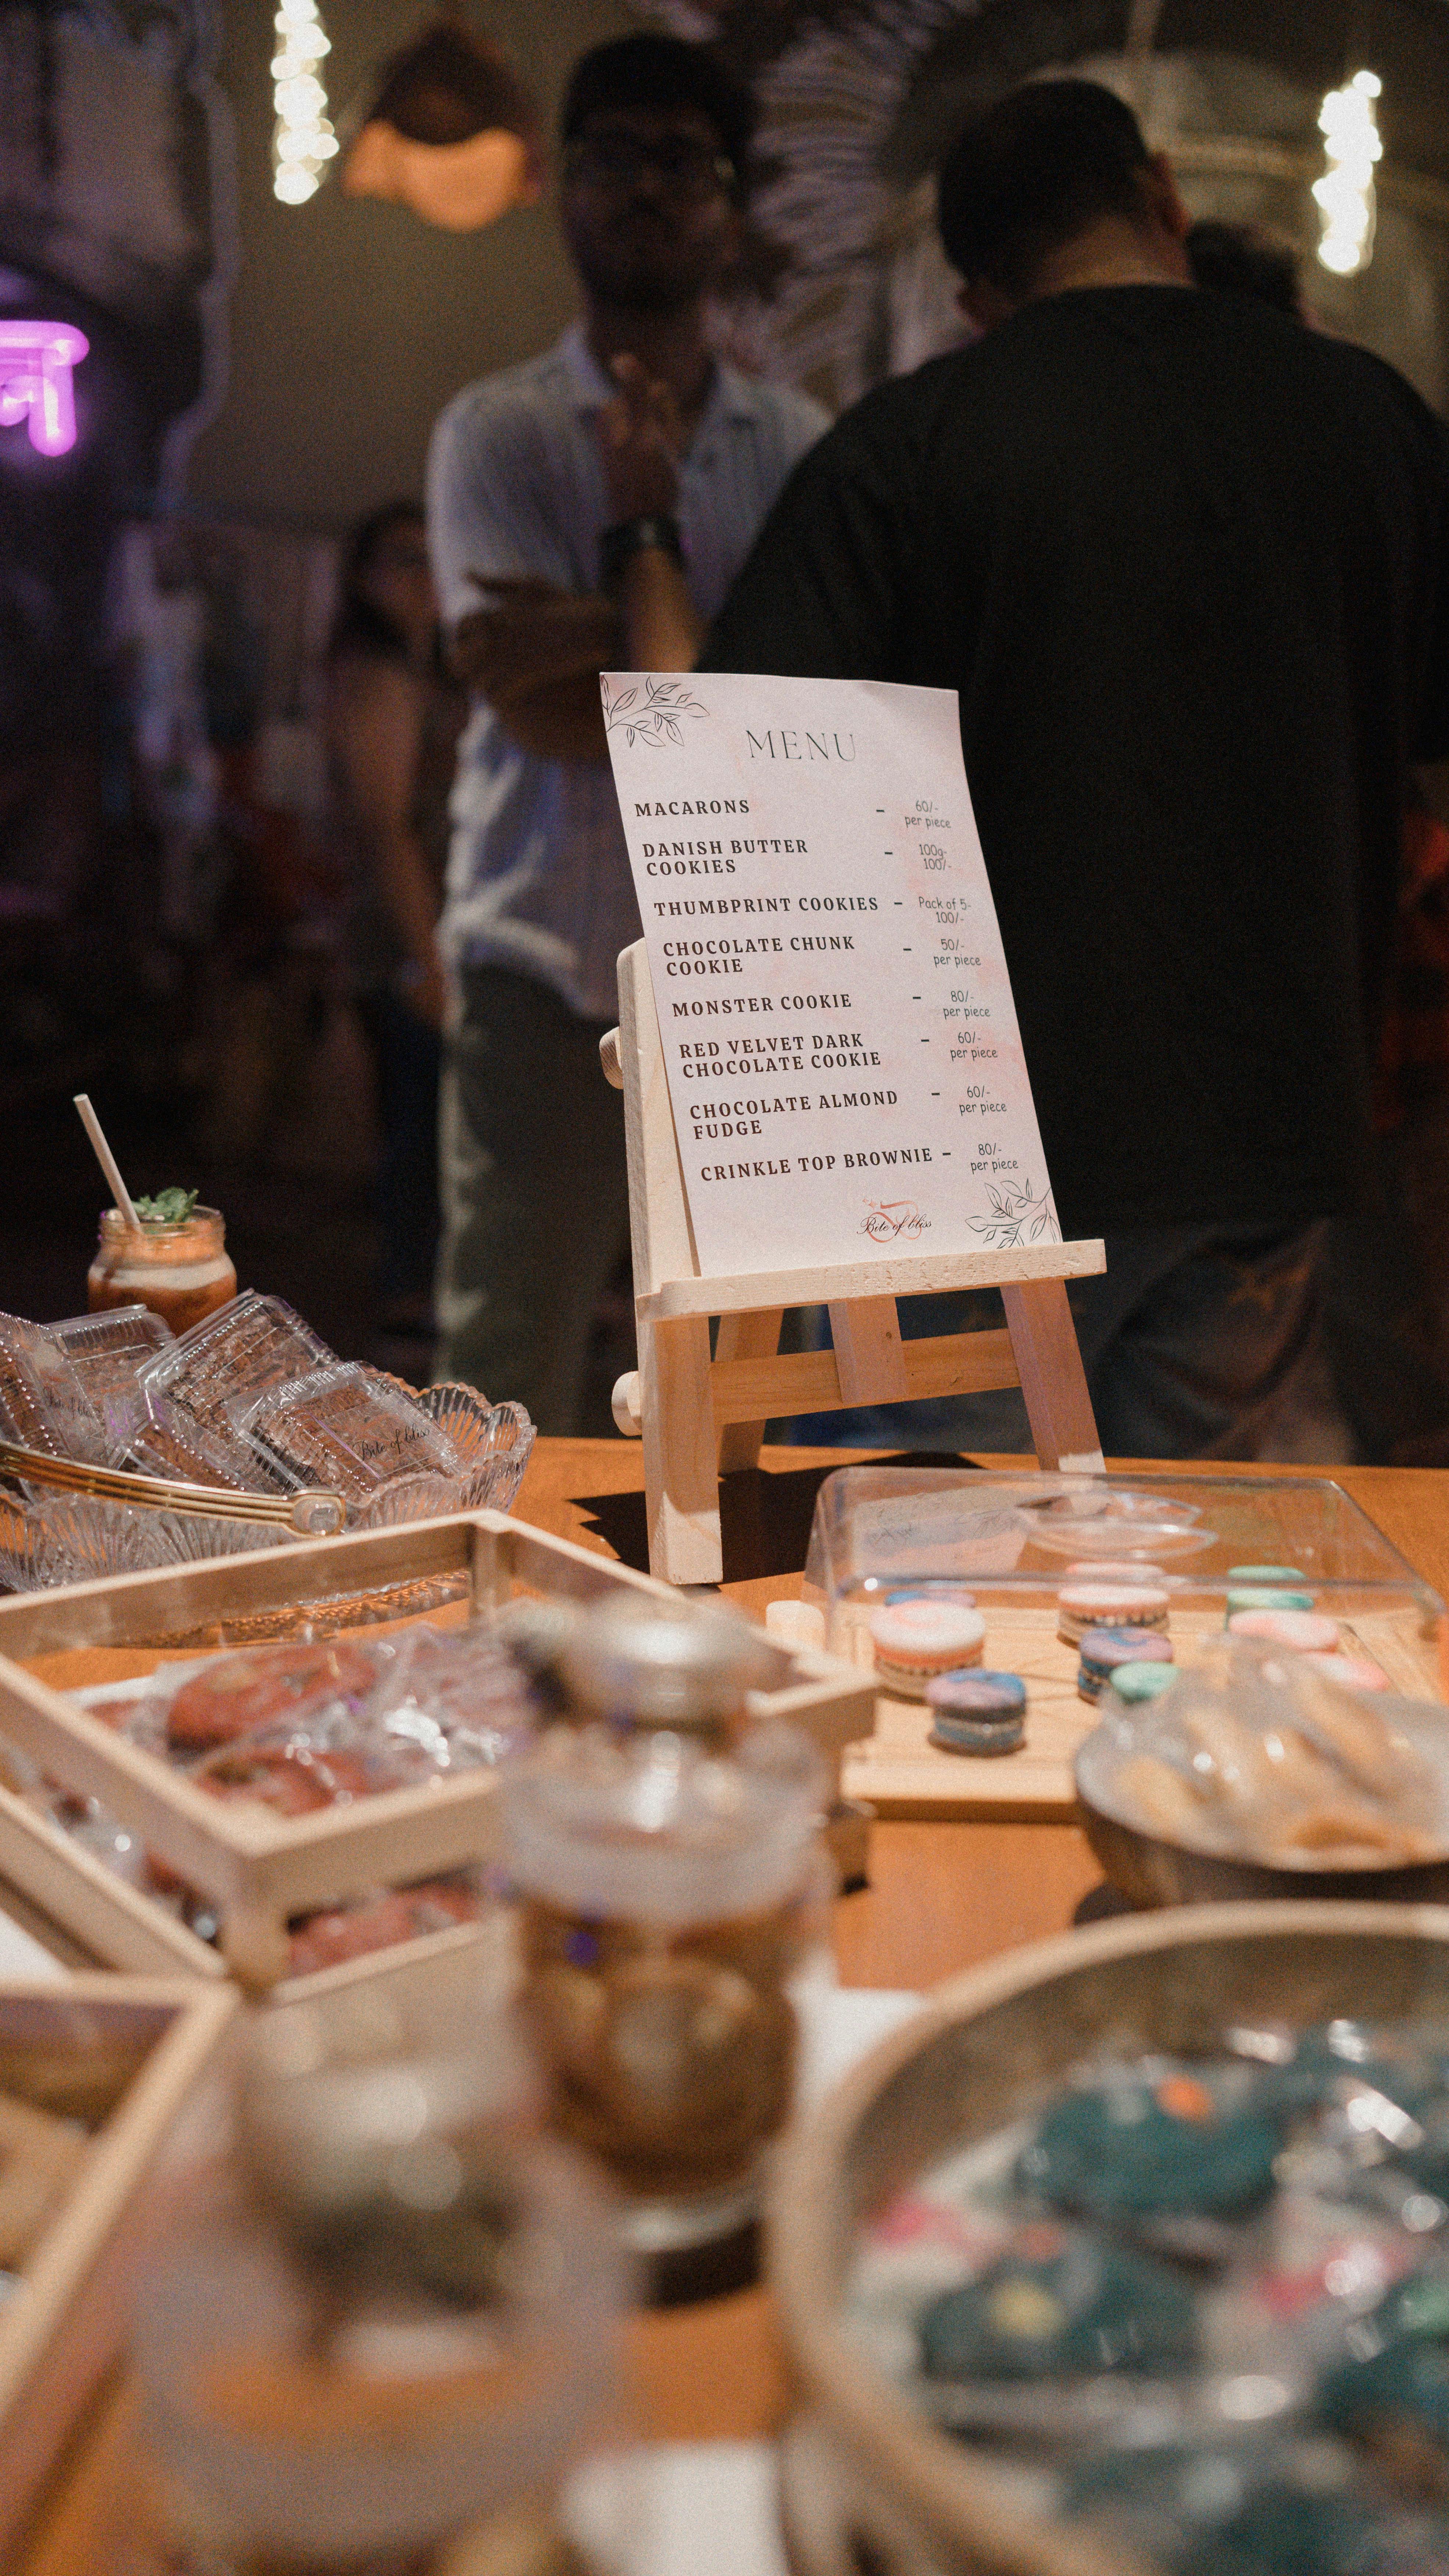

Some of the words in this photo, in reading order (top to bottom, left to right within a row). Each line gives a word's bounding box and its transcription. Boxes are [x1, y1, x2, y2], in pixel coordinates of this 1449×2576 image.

[745, 730, 856, 762] MENU
[634, 799, 749, 817] MACARONS
[915, 799, 938, 813] 60/-
[904, 816, 922, 829] per
[925, 815, 952, 830] piece
[642, 840, 723, 858] DANISH
[730, 839, 808, 854] BUTTER
[646, 859, 736, 876] COOKIES
[923, 858, 952, 871] 100/-
[654, 898, 791, 916] THUMBPRINT
[798, 897, 878, 912] COOKIES
[918, 896, 944, 909] Pack
[946, 898, 957, 910] of
[935, 911, 964, 924] 100/-
[663, 937, 783, 957] CHOCOLATE
[790, 936, 855, 951] CHUNK
[940, 938, 965, 951] 50/-
[666, 958, 743, 977] COOKIE
[933, 956, 951, 968] per
[954, 954, 981, 968] piece
[672, 997, 774, 1017] MONSTER
[780, 994, 852, 1010] COOKIE
[950, 990, 974, 1003] 80/-
[942, 1008, 960, 1020] per
[963, 1005, 990, 1020] piece
[679, 1042, 720, 1059] RED
[727, 1036, 804, 1055] VELVET
[812, 1033, 863, 1049] DARK
[957, 1031, 981, 1044] 60/-
[949, 1049, 968, 1062] per
[970, 1046, 998, 1062] piece
[683, 1056, 804, 1078] CHOCOLATE
[811, 1052, 881, 1069] COOKIE
[690, 1096, 811, 1120] CHOCOLATE
[819, 1090, 898, 1109] ALMOND
[966, 1085, 990, 1098] 60/-
[959, 1103, 977, 1116] per
[980, 1101, 1007, 1116] piece
[693, 1120, 762, 1140] FUDGE
[701, 1159, 791, 1182] CRINKLE
[797, 1155, 836, 1172] TOP
[843, 1148, 933, 1168] BROWNIE
[978, 1142, 1002, 1156] 80/-
[970, 1161, 988, 1175] per
[991, 1158, 1019, 1173] piece
[857, 1216, 890, 1234] Bite
[892, 1215, 910, 1236] of
[908, 1214, 932, 1230] bliss
[353, 1439, 386, 1461] Bite
[390, 1429, 402, 1454] of
[405, 1423, 429, 1443] bliss
